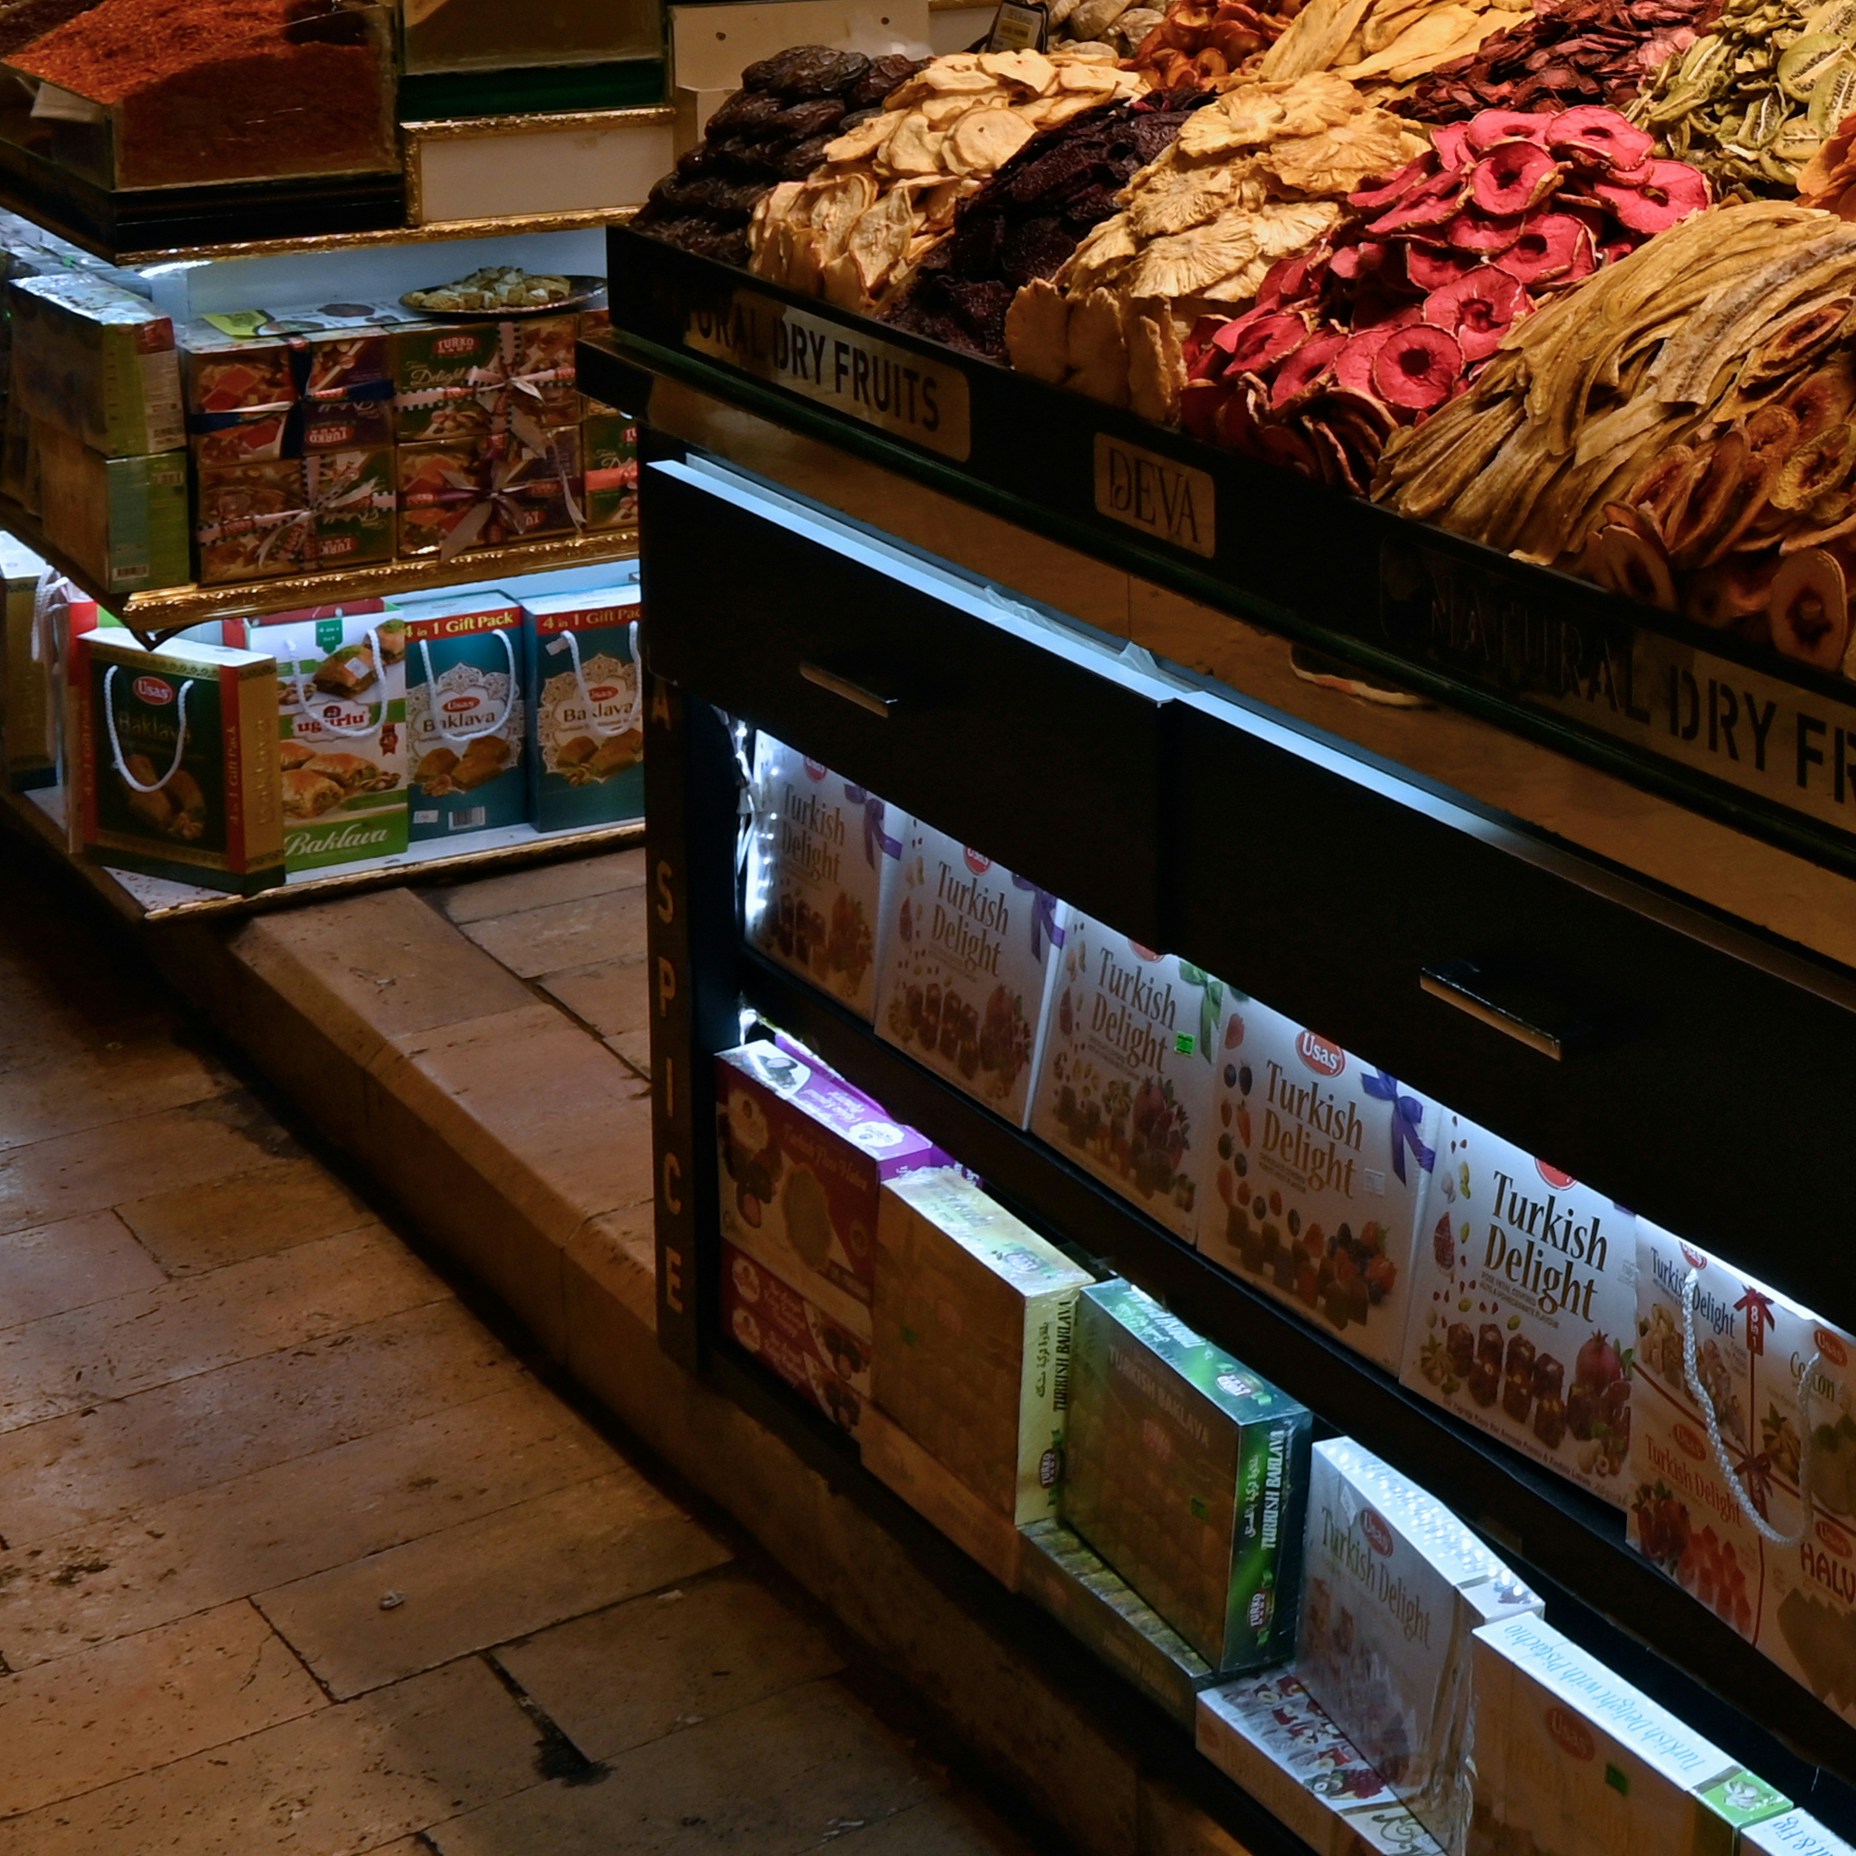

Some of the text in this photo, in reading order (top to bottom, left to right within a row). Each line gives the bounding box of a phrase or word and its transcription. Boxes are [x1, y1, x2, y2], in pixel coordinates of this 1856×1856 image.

[437, 337, 476, 351] TURKO
[772, 315, 942, 434] DRY FRUITS
[445, 612, 514, 635] Gift Pack
[542, 609, 612, 630] 4 in Gift
[1668, 660, 1778, 773] DRY
[284, 823, 388, 859] Baklava
[782, 780, 846, 845] Turkish
[780, 823, 842, 886] Delight
[936, 858, 1010, 938] Turkish
[931, 900, 1003, 980] Delight
[1099, 943, 1178, 1033] Turkish
[1091, 991, 1168, 1076] Delight
[1265, 1058, 1364, 1151] Turkish
[1261, 1105, 1357, 1200] Delight
[1492, 1168, 1609, 1273] Turkish
[1482, 1223, 1597, 1325] Delight
[1053, 1300, 1072, 1412] TURKISH BAKLAVA
[1040, 1452, 1051, 1486] TURKO
[1260, 1429, 1287, 1551] TURKISH BAKLAVA
[1644, 1432, 1696, 1490] Turkish
[1250, 1592, 1261, 1629] TURKO
